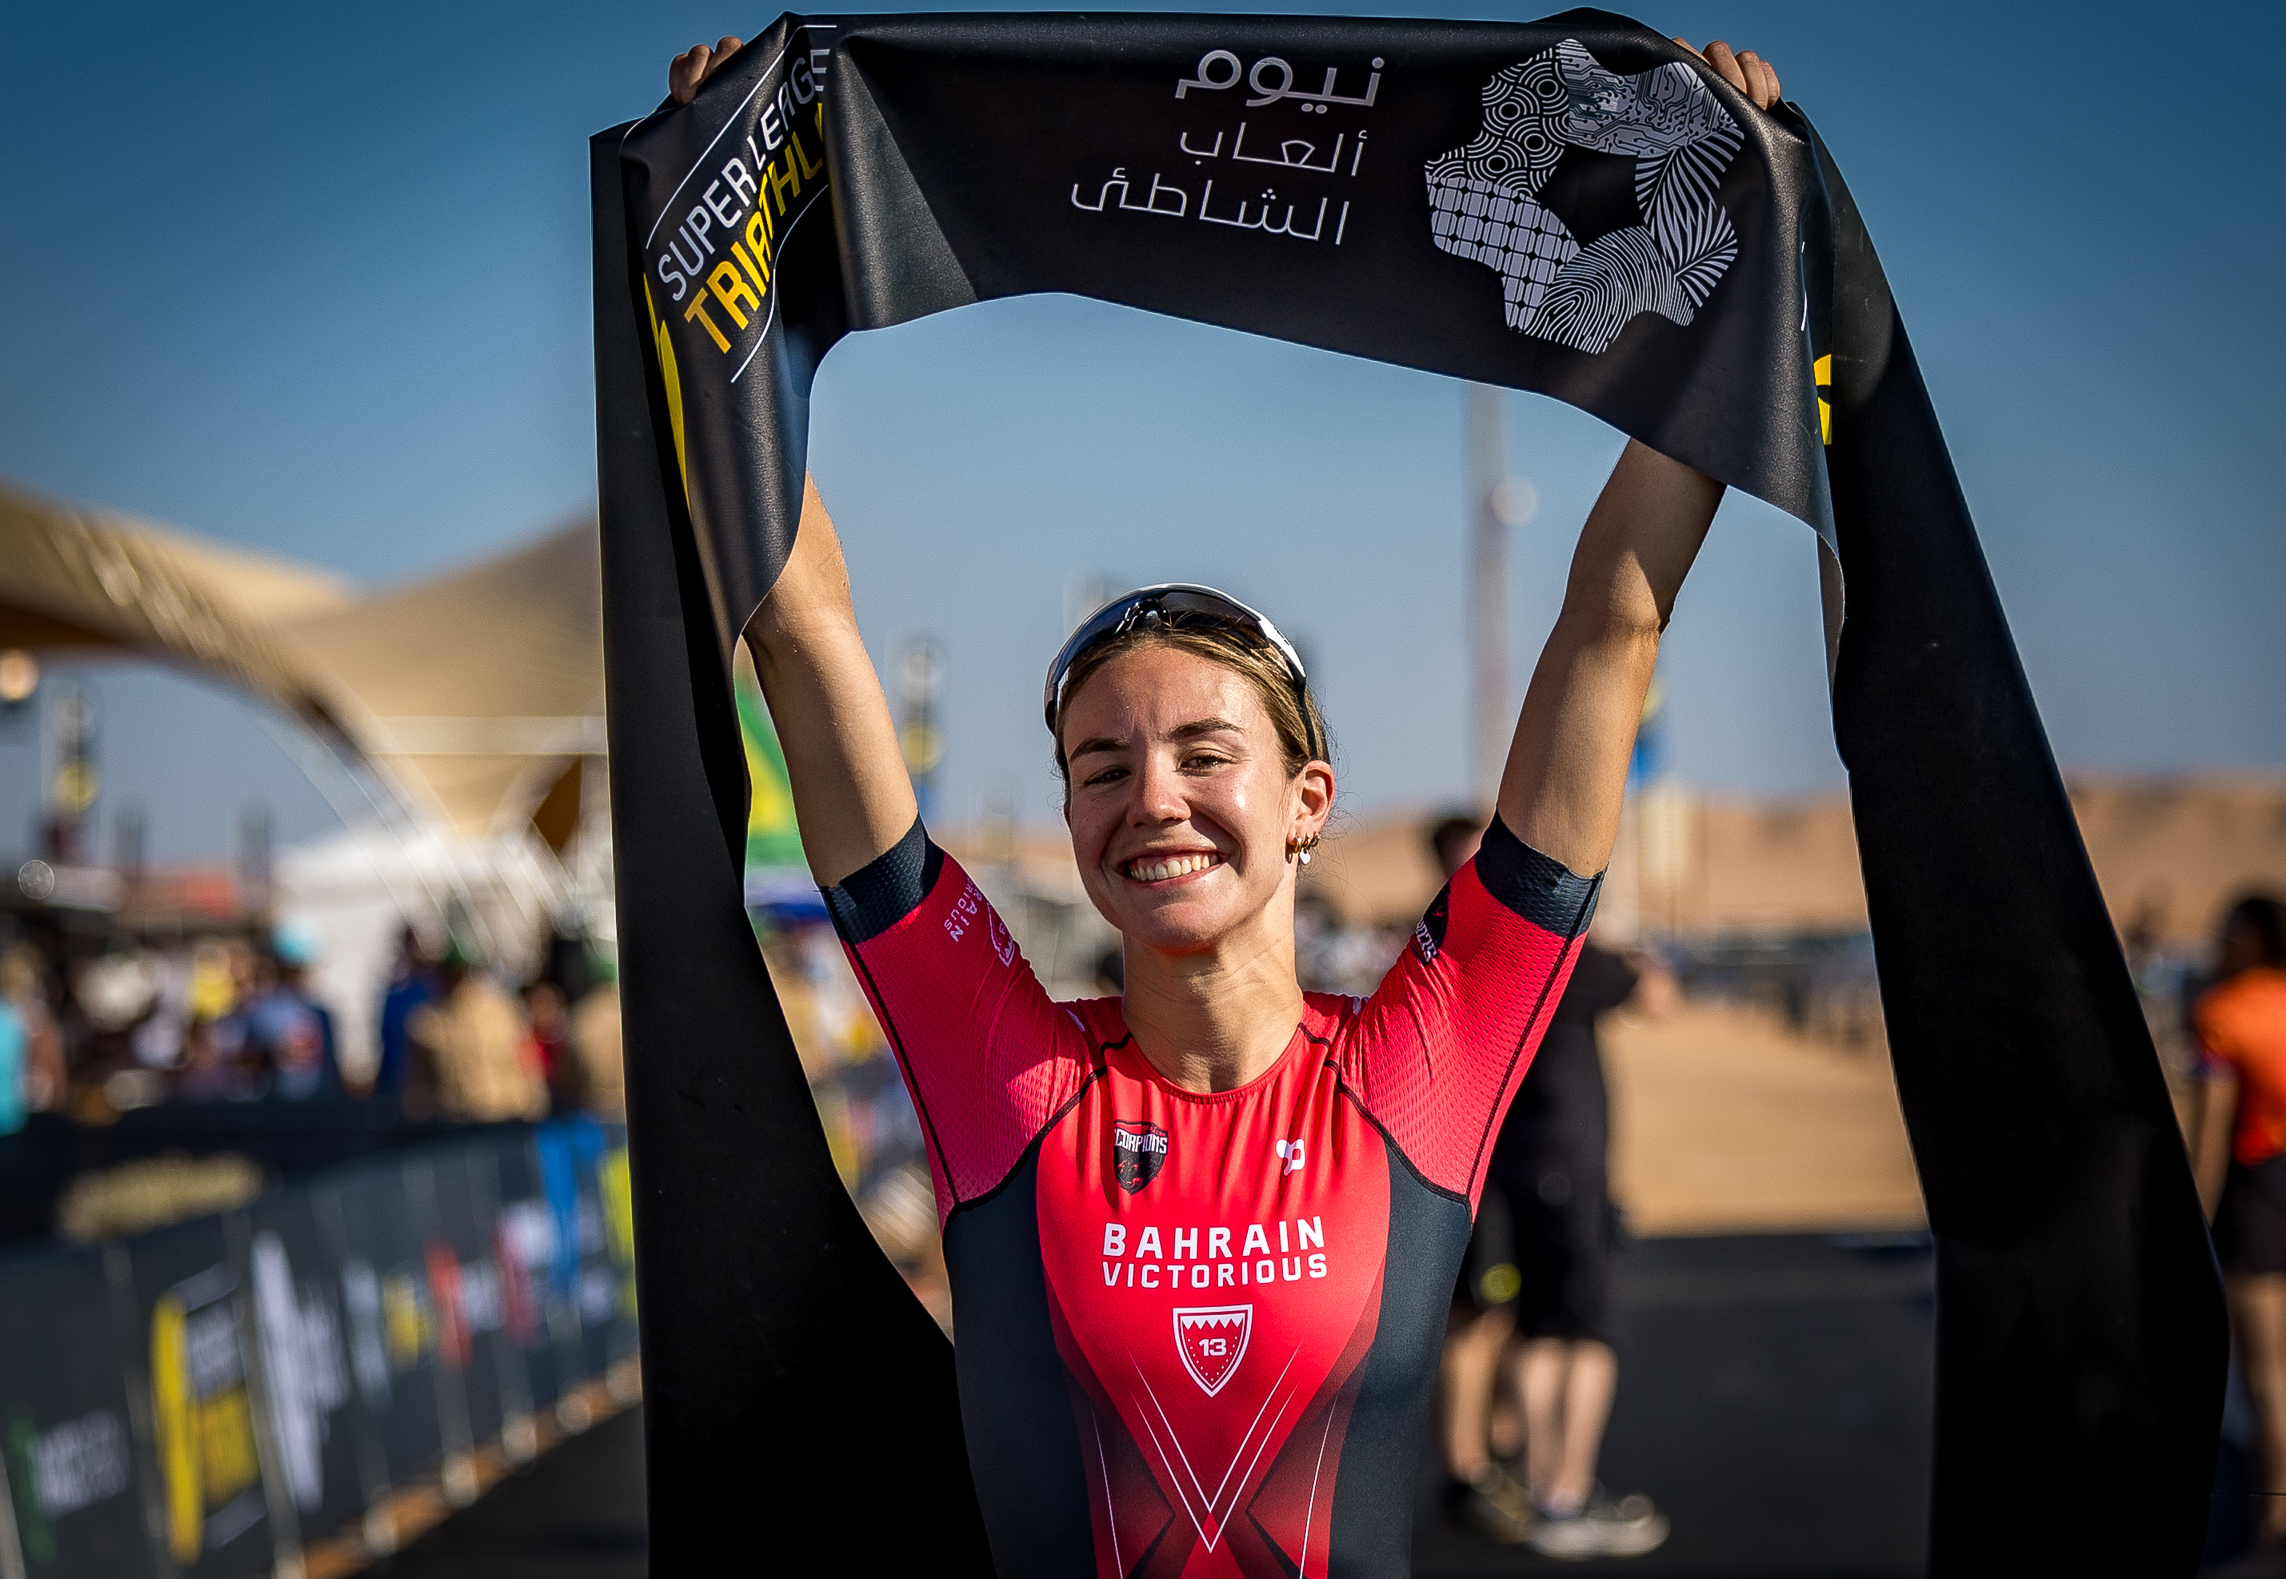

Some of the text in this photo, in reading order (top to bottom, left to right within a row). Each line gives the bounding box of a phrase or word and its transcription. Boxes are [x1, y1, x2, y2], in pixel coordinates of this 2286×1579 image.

[1175, 50, 1384, 114] نيوم
[658, 49, 830, 301] SUPER LEAGE
[1179, 122, 1367, 176] ألعاب
[684, 102, 823, 354] TRIATHL
[1071, 167, 1349, 245] الشاطئ
[950, 888, 983, 942] RAIN
[1114, 1127, 1168, 1154] CORPIONS
[1102, 1216, 1325, 1260] BAHRAIN
[1102, 1253, 1328, 1289] VICTORIOUS
[1199, 1338, 1227, 1356] 13
